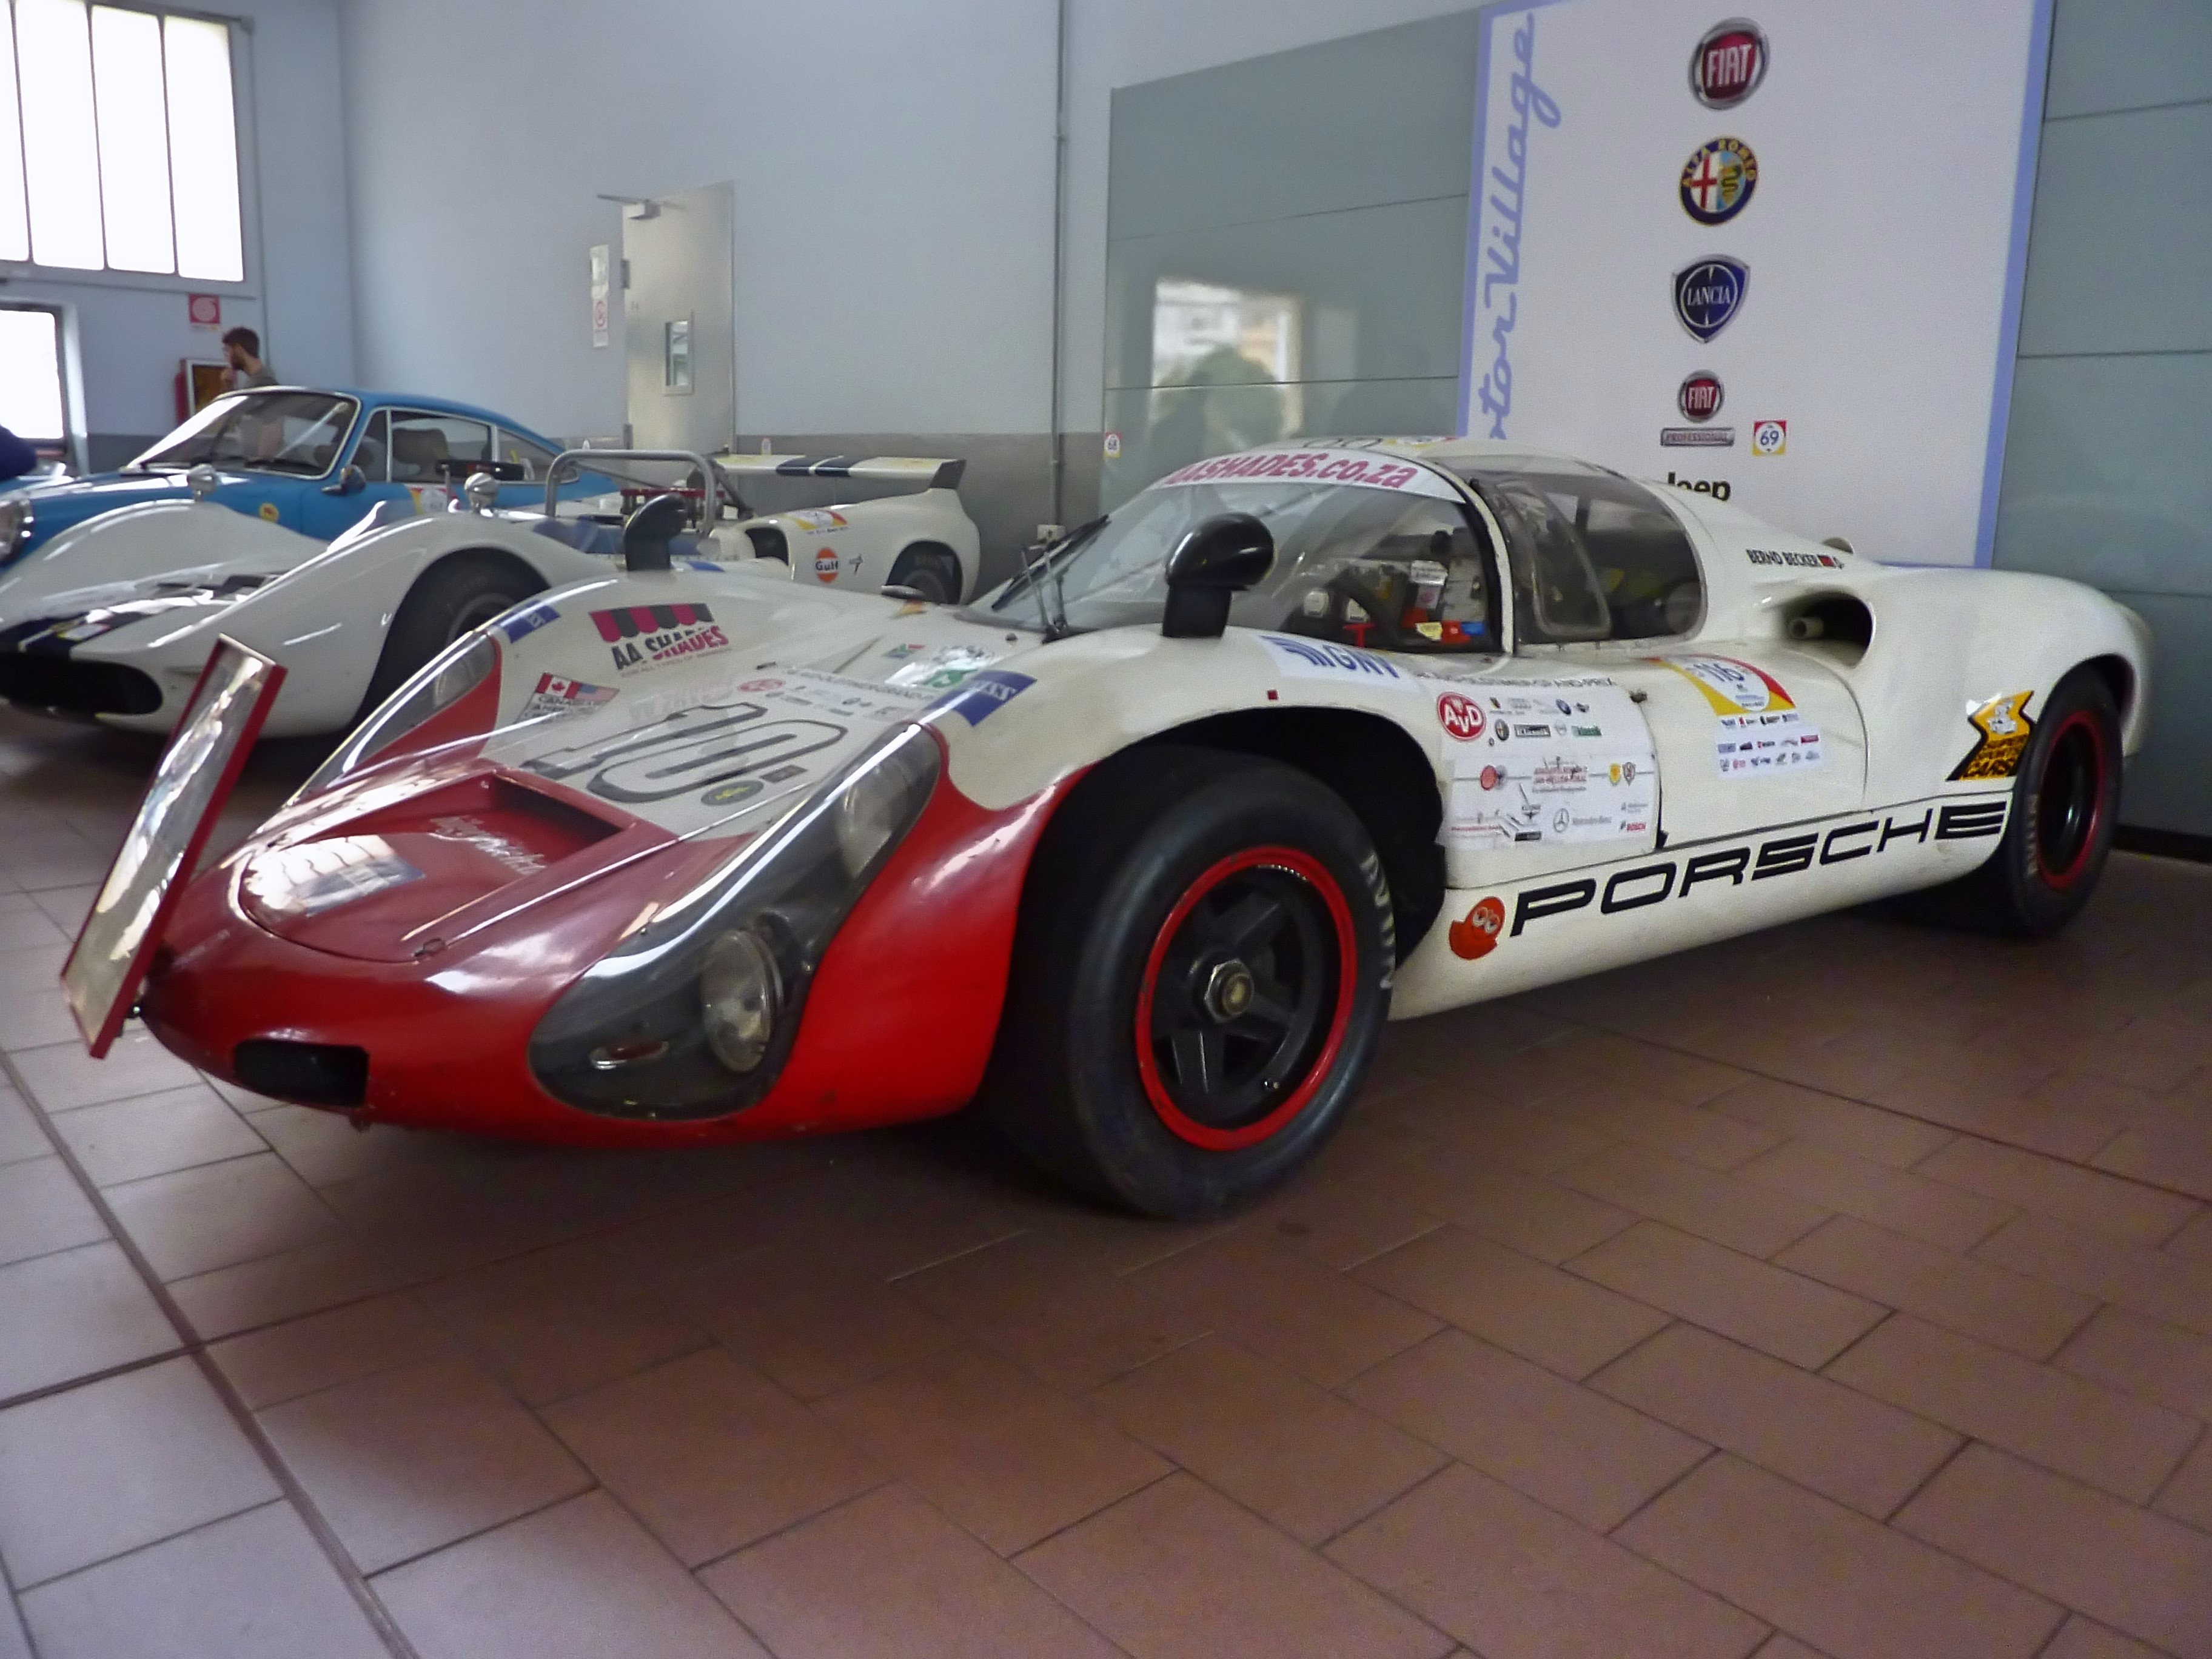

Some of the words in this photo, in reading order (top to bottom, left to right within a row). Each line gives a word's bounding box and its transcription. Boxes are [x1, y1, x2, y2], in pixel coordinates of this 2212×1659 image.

[1706, 43, 1752, 89] FIAT
[1687, 284, 1731, 306] LANCIA
[1687, 386, 1715, 410] FIAT
[1760, 430, 1780, 446] 69
[815, 560, 839, 571] Gulf
[1509, 801, 2008, 937] PORSCHE
